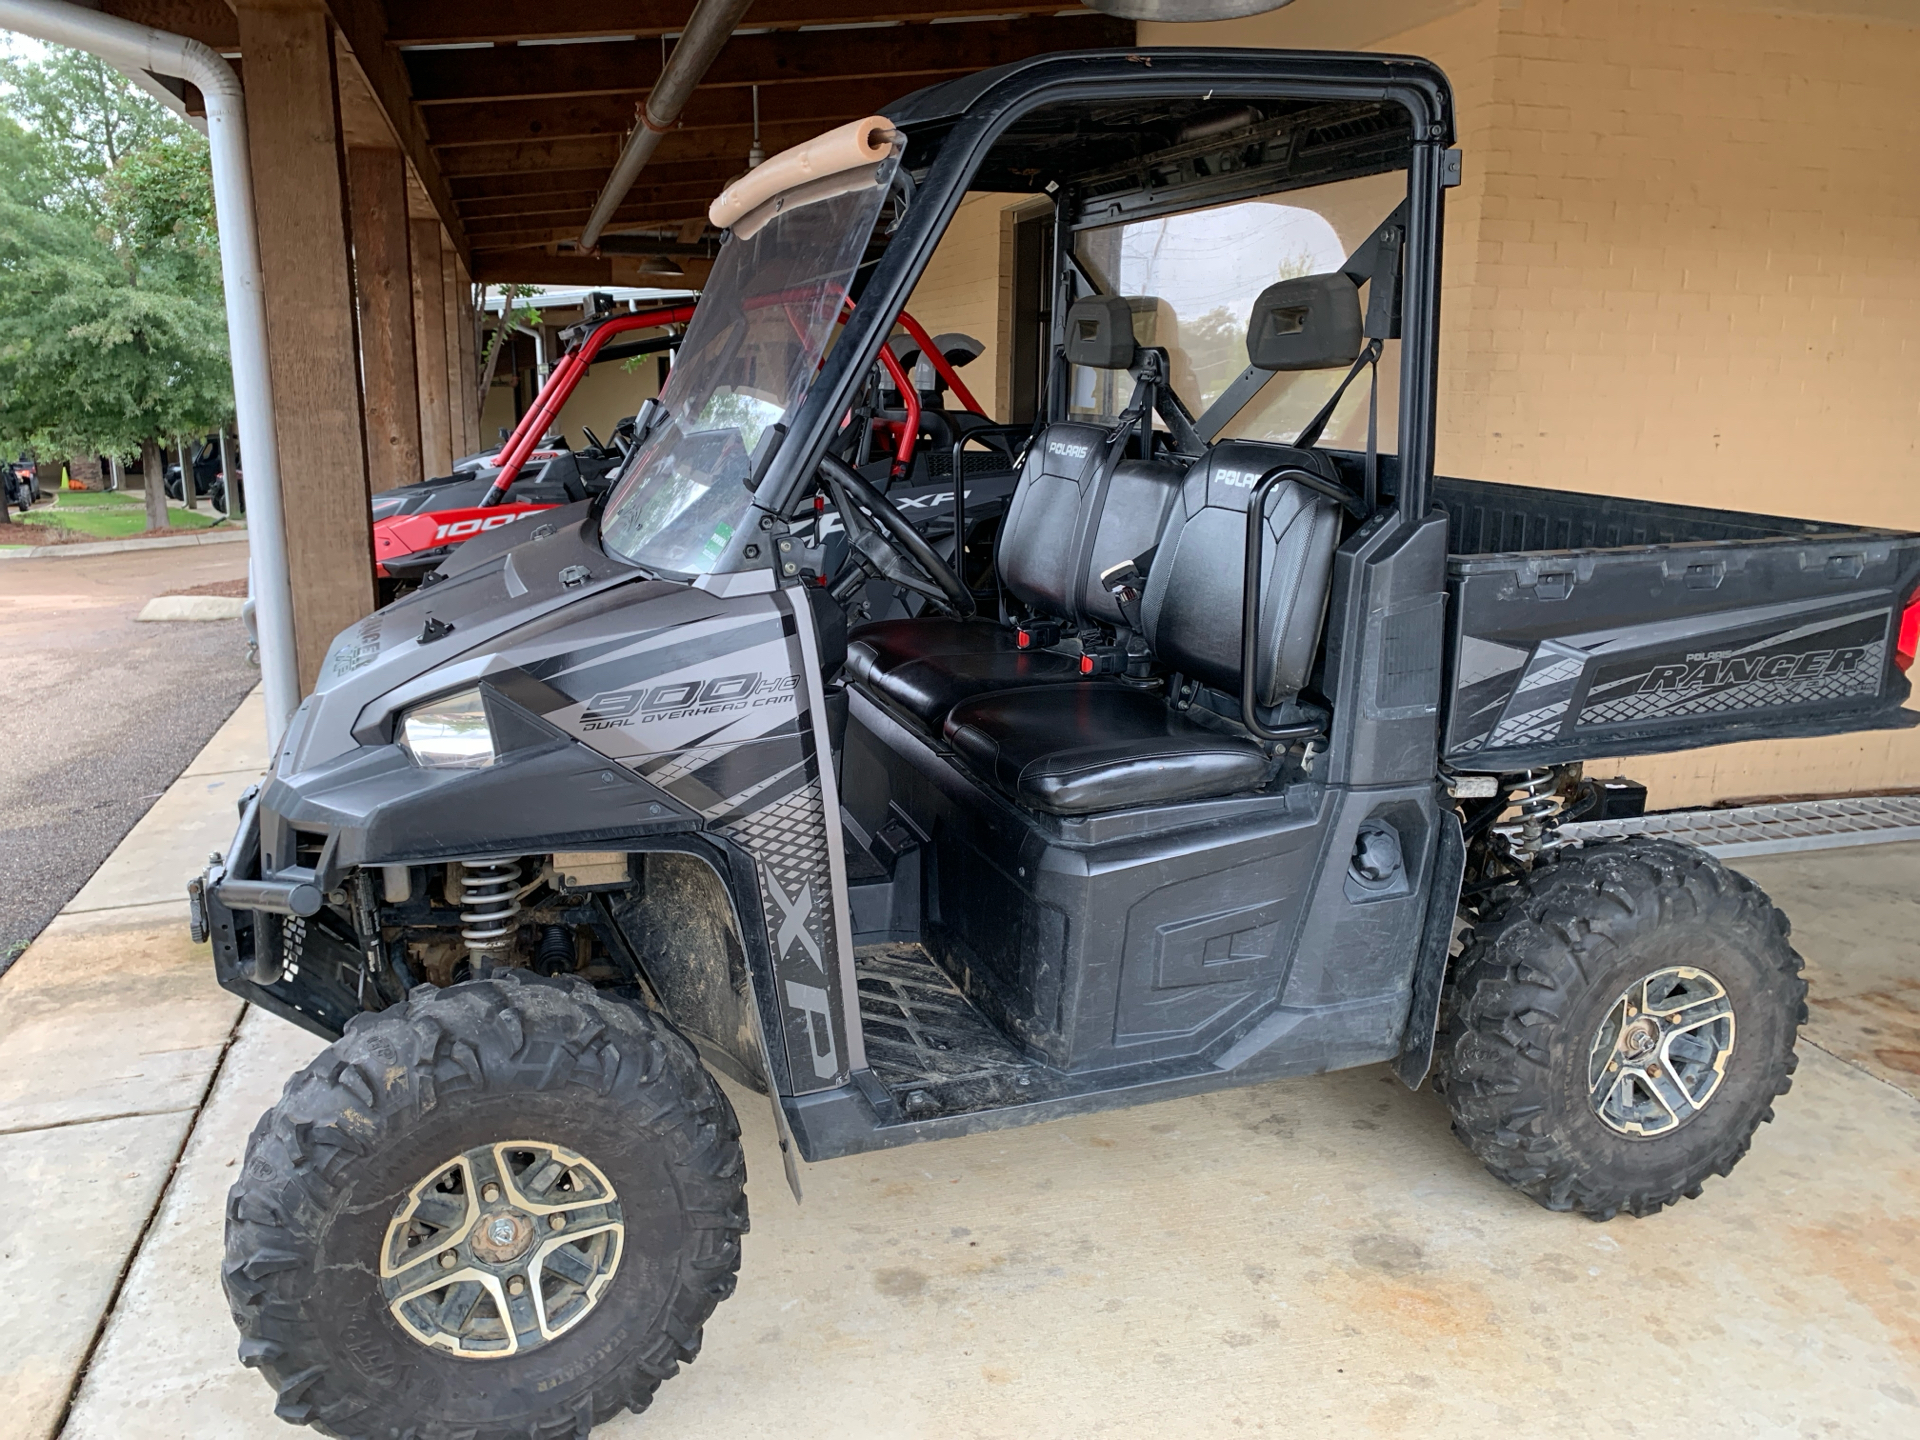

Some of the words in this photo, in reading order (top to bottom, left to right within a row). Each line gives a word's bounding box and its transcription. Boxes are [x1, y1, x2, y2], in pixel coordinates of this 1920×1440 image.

[1049, 441, 1088, 459] POLARIS
[1214, 469, 1280, 492] POLAS
[1637, 646, 1867, 694] RANGER
[1686, 650, 1732, 662] POLARIS
[579, 671, 763, 724] 900
[754, 674, 801, 695] HO
[1764, 677, 1827, 699] XP
[582, 719, 636, 732] DUAL
[641, 701, 748, 724] OVERHEAD
[751, 694, 794, 708] CAM
[764, 862, 840, 1080] XP
